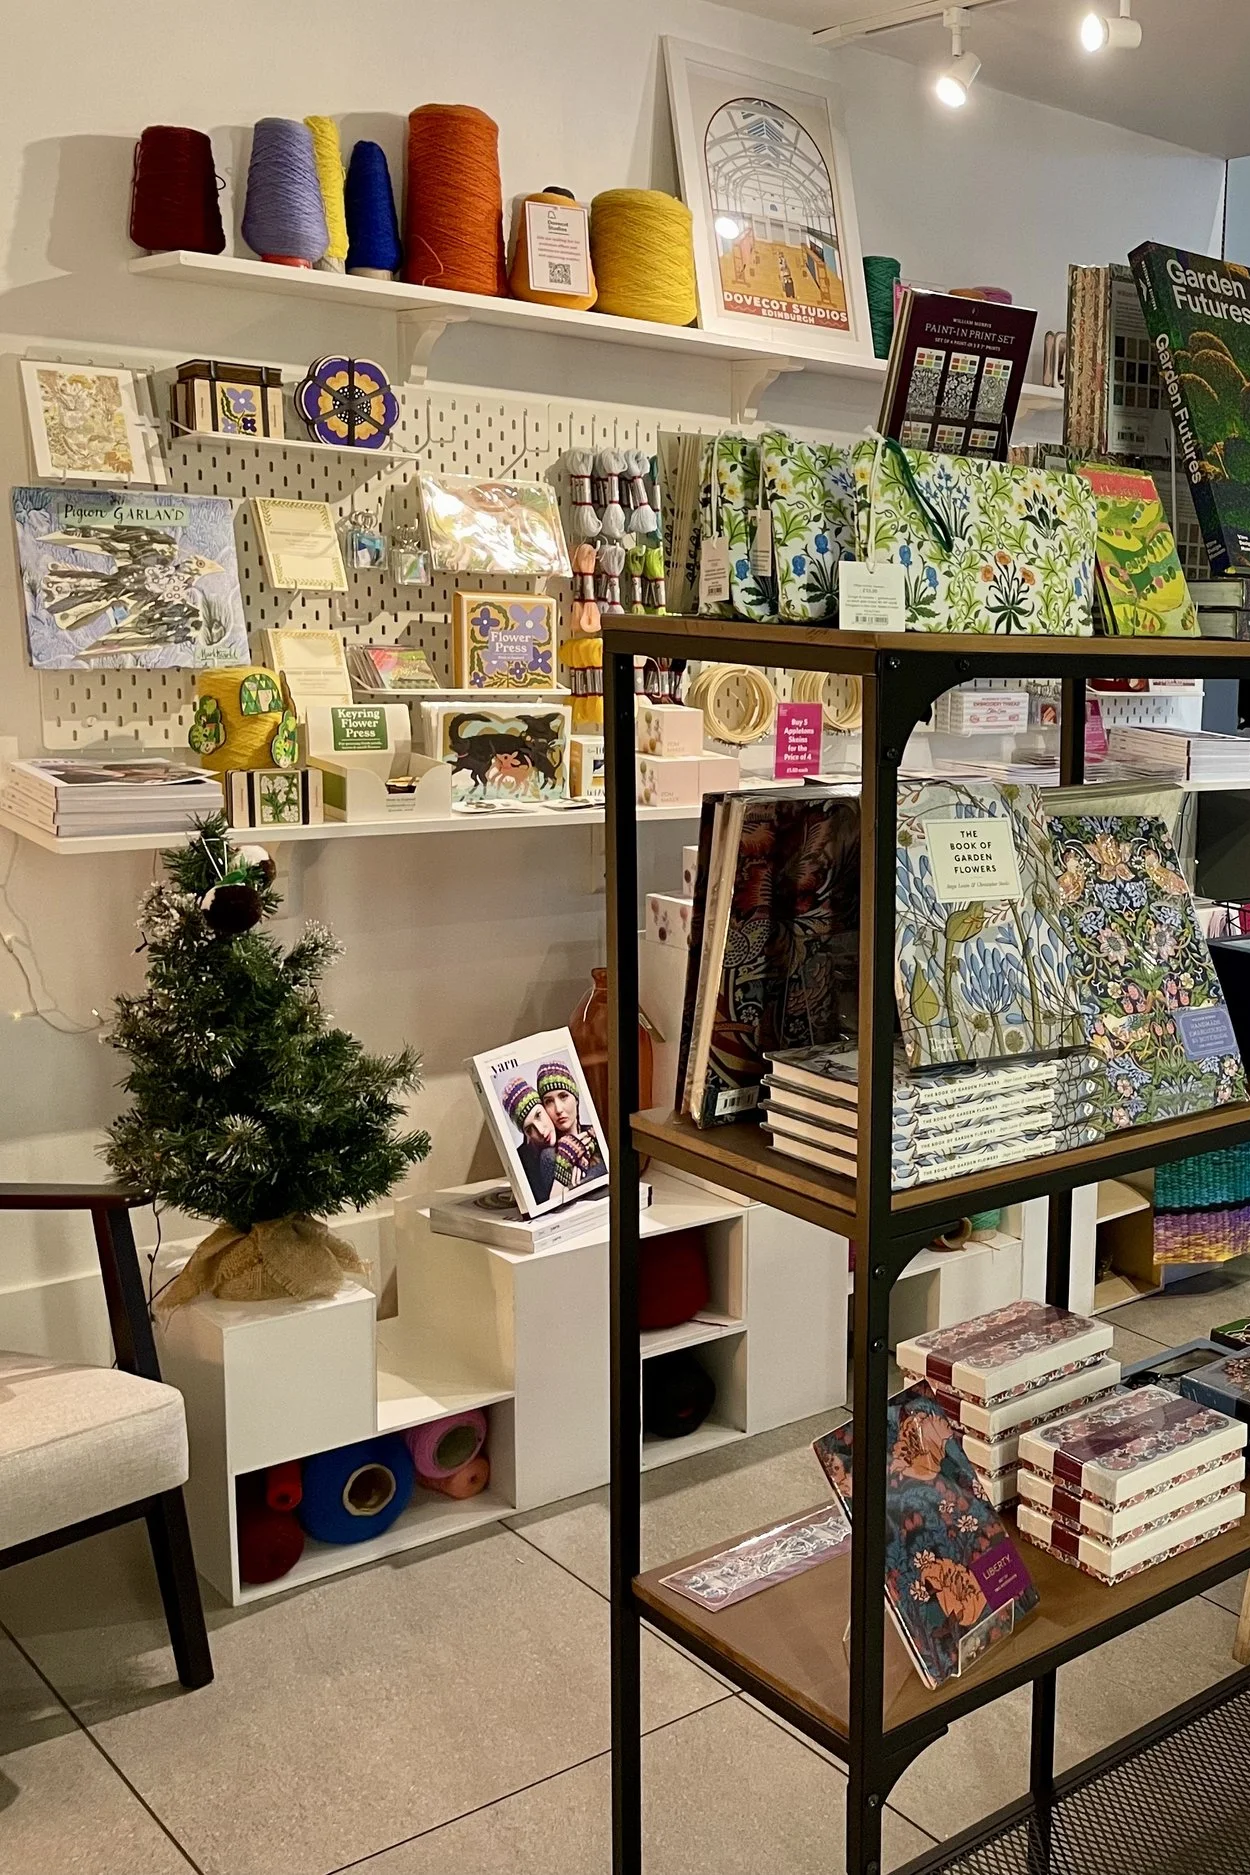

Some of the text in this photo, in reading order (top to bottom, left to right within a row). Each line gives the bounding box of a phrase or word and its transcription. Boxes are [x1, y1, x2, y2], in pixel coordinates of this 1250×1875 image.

[1166, 259, 1246, 300] Garden
[723, 292, 848, 322] DOVECOT STUDIOS
[762, 309, 814, 324] EDINBURGH
[925, 323, 1015, 345] PAINT-IN PRINT SET
[1156, 333, 1202, 484] Garden Futures
[114, 506, 184, 524] GARLAND
[491, 631, 531, 642] Flower
[495, 642, 527, 652] Press
[338, 709, 380, 720] Keyring
[342, 719, 378, 728] Flower
[791, 718, 803, 727] Buy
[346, 728, 376, 738] Press
[950, 841, 992, 850] BOOK OF
[954, 853, 992, 862] GARDEN
[955, 864, 997, 874] FLOWERS
[491, 1058, 519, 1079] yarn
[983, 1554, 1010, 1580] LIBERTY
